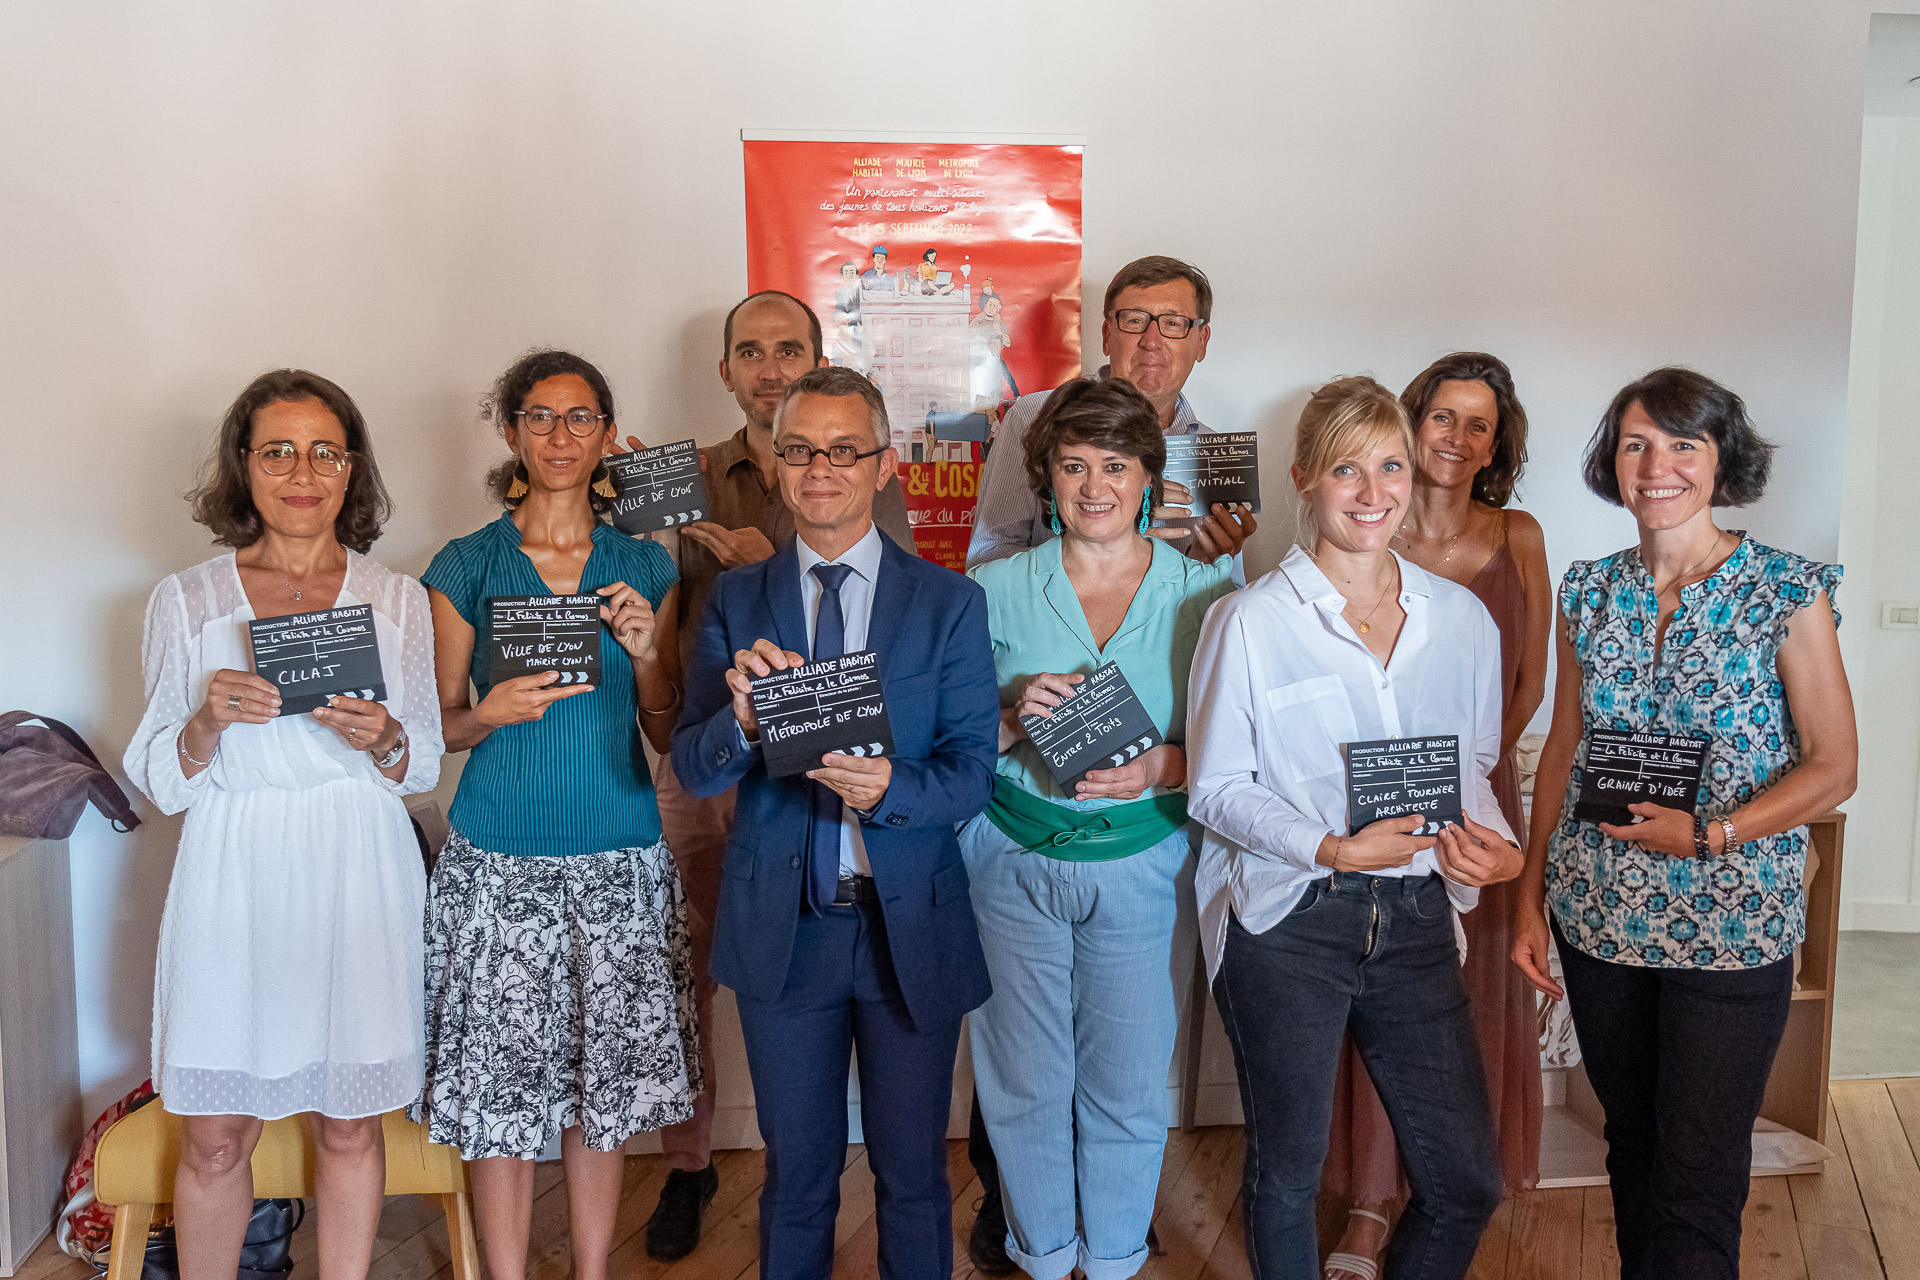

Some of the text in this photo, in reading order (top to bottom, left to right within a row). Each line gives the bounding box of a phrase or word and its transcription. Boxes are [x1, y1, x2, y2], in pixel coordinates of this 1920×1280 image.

[854, 158, 881, 166] ALLIADE
[896, 159, 925, 167] MAIRIE
[853, 168, 882, 177] HABITAT
[897, 169, 926, 177] DE LYON
[944, 169, 973, 177] DE LYON
[846, 185, 861, 197] Un
[863, 188, 917, 200] partenariat
[820, 200, 835, 210] des
[838, 202, 869, 214] jeunes
[872, 200, 883, 211] de
[886, 202, 906, 211] tous
[859, 223, 972, 236] LE 5 SEPTEMBRE 2022
[664, 442, 692, 454] HABITAT
[651, 490, 665, 502] DE
[671, 483, 693, 497] LYON
[937, 508, 953, 523] du
[529, 597, 563, 607] ALLIADE
[567, 596, 599, 604] HABITAT
[292, 613, 329, 626] ALLIADE
[332, 608, 368, 619] HABITAT
[336, 625, 366, 634] Cosmos
[539, 644, 554, 653] DE
[557, 641, 583, 652] LYON
[562, 657, 582, 665] LYON
[793, 661, 836, 679] ALLIADE
[840, 653, 876, 669] HABITAT
[278, 664, 341, 684] CLLAJ
[826, 677, 837, 688] le
[840, 673, 869, 685] Cosmos
[1091, 665, 1117, 685] HABITAT
[1091, 685, 1115, 700] Cosmos
[768, 703, 882, 742] MÉTROPOLE DE LYON
[1427, 740, 1456, 748] HABITAT
[1630, 734, 1666, 744] ALLIADE
[1670, 738, 1704, 748] HABITAT
[1052, 742, 1082, 767] ENTRE
[1086, 733, 1096, 744] 2
[1597, 777, 1643, 791] GRAINE
[1358, 785, 1454, 805] CLAIRE TOURNIER
[1376, 799, 1438, 818] ARCHITECTE
